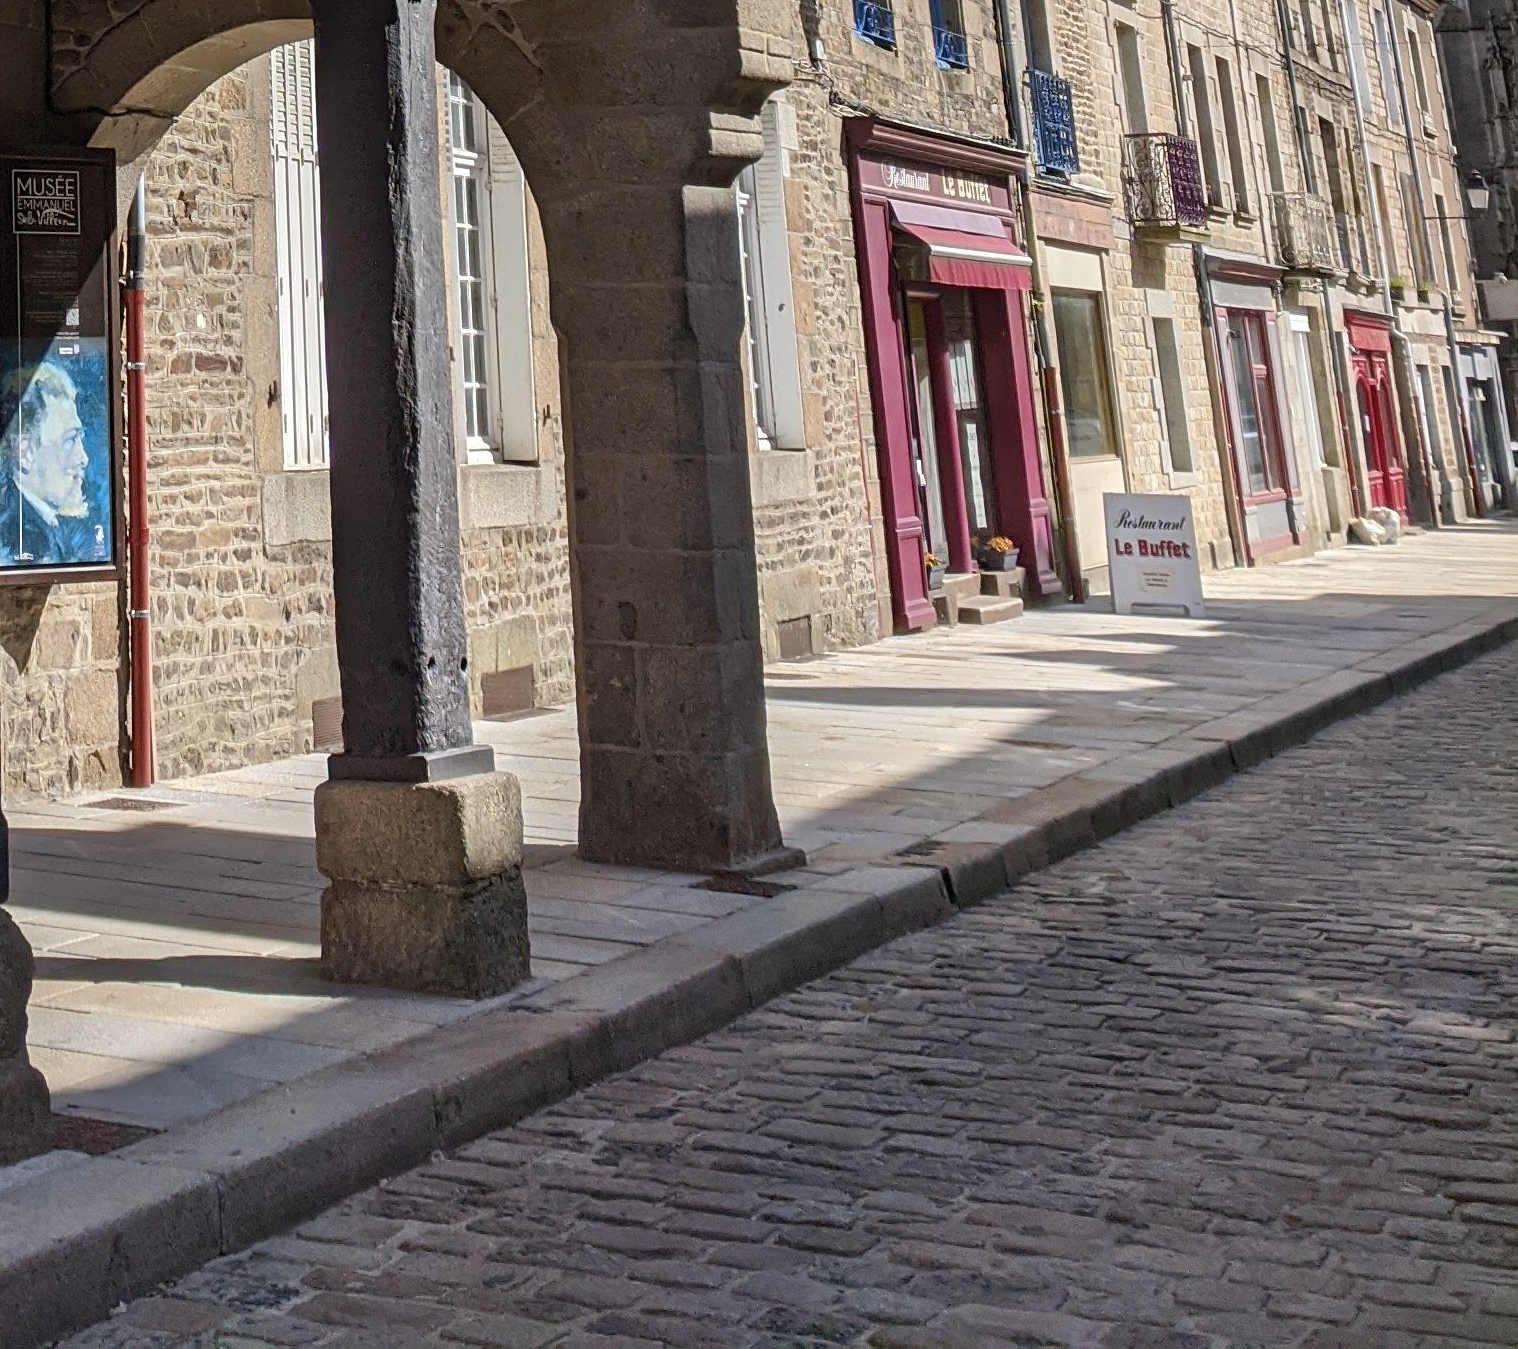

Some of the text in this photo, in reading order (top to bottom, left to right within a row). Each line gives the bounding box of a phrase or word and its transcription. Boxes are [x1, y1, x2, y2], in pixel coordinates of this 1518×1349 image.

[16, 174, 75, 197] MUSÉE
[16, 197, 76, 211] EMMANUEL
[1115, 508, 1186, 531] Restaurant
[1113, 537, 1192, 560] Le Buffet
